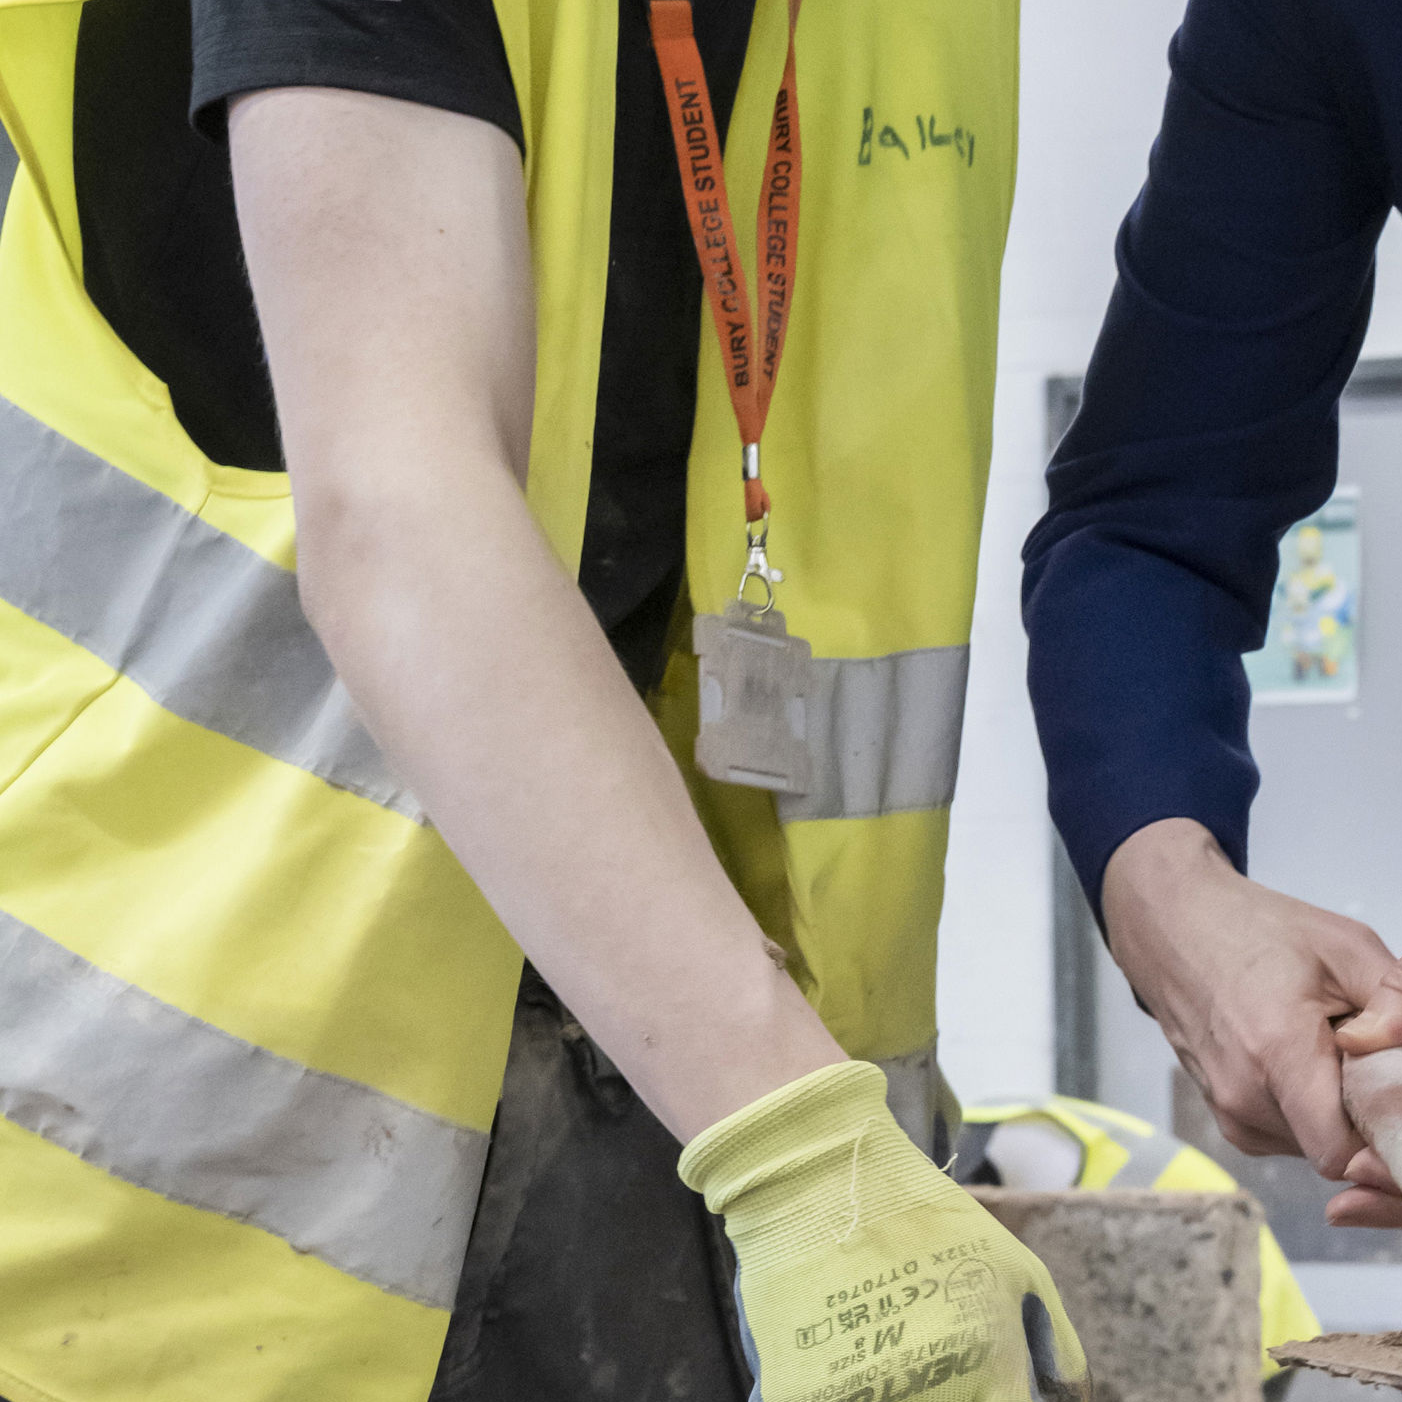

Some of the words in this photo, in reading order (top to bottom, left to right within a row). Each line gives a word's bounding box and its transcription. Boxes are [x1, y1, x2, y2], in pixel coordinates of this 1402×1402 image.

[675, 77, 715, 192] STUDENT
[774, 89, 792, 153] BURY
[698, 198, 740, 313] COLLEGE
[766, 160, 792, 268] COLLEGE
[726, 321, 749, 388] BURY
[764, 271, 787, 382] STUDENT
[829, 1351, 866, 1375] SIZE
[873, 1320, 905, 1355] M
